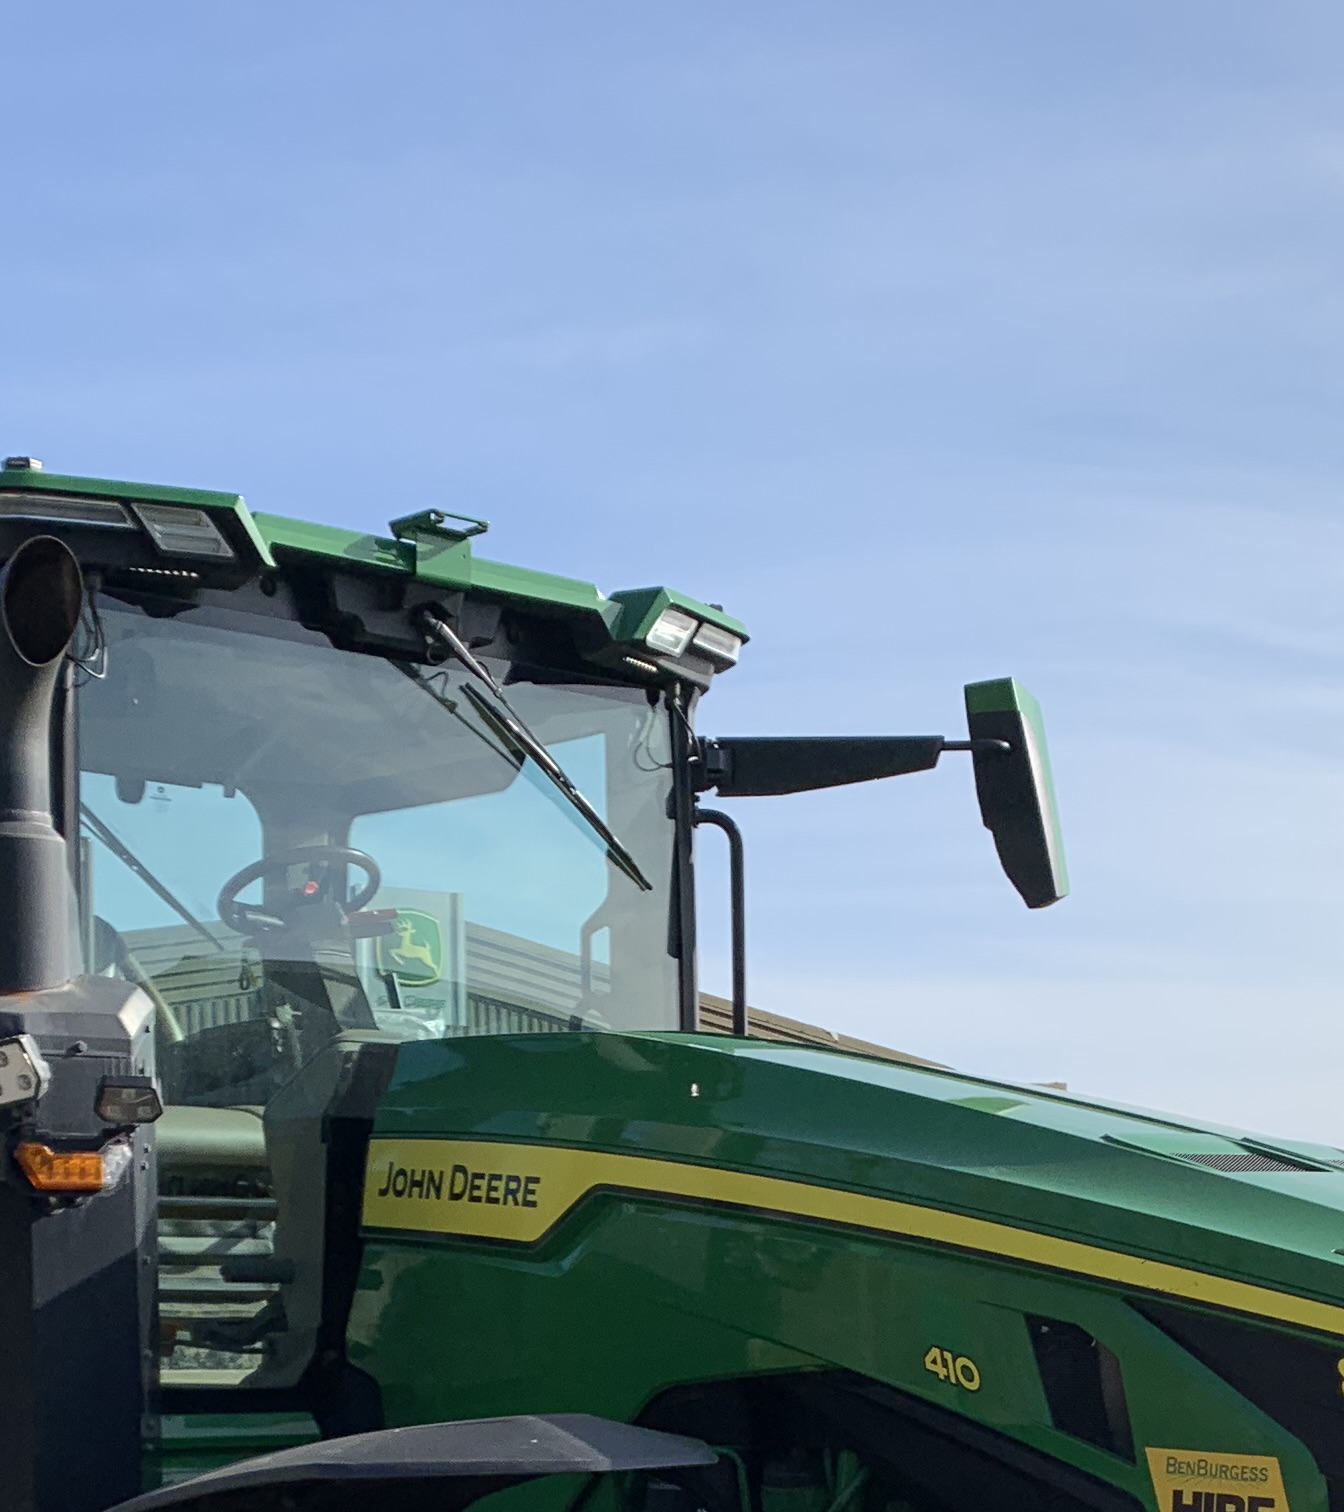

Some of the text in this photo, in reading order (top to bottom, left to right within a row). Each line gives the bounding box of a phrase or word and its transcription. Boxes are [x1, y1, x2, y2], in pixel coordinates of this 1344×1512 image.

[378, 1162, 541, 1208] JOHN DEERE
[923, 1346, 981, 1392] 410
